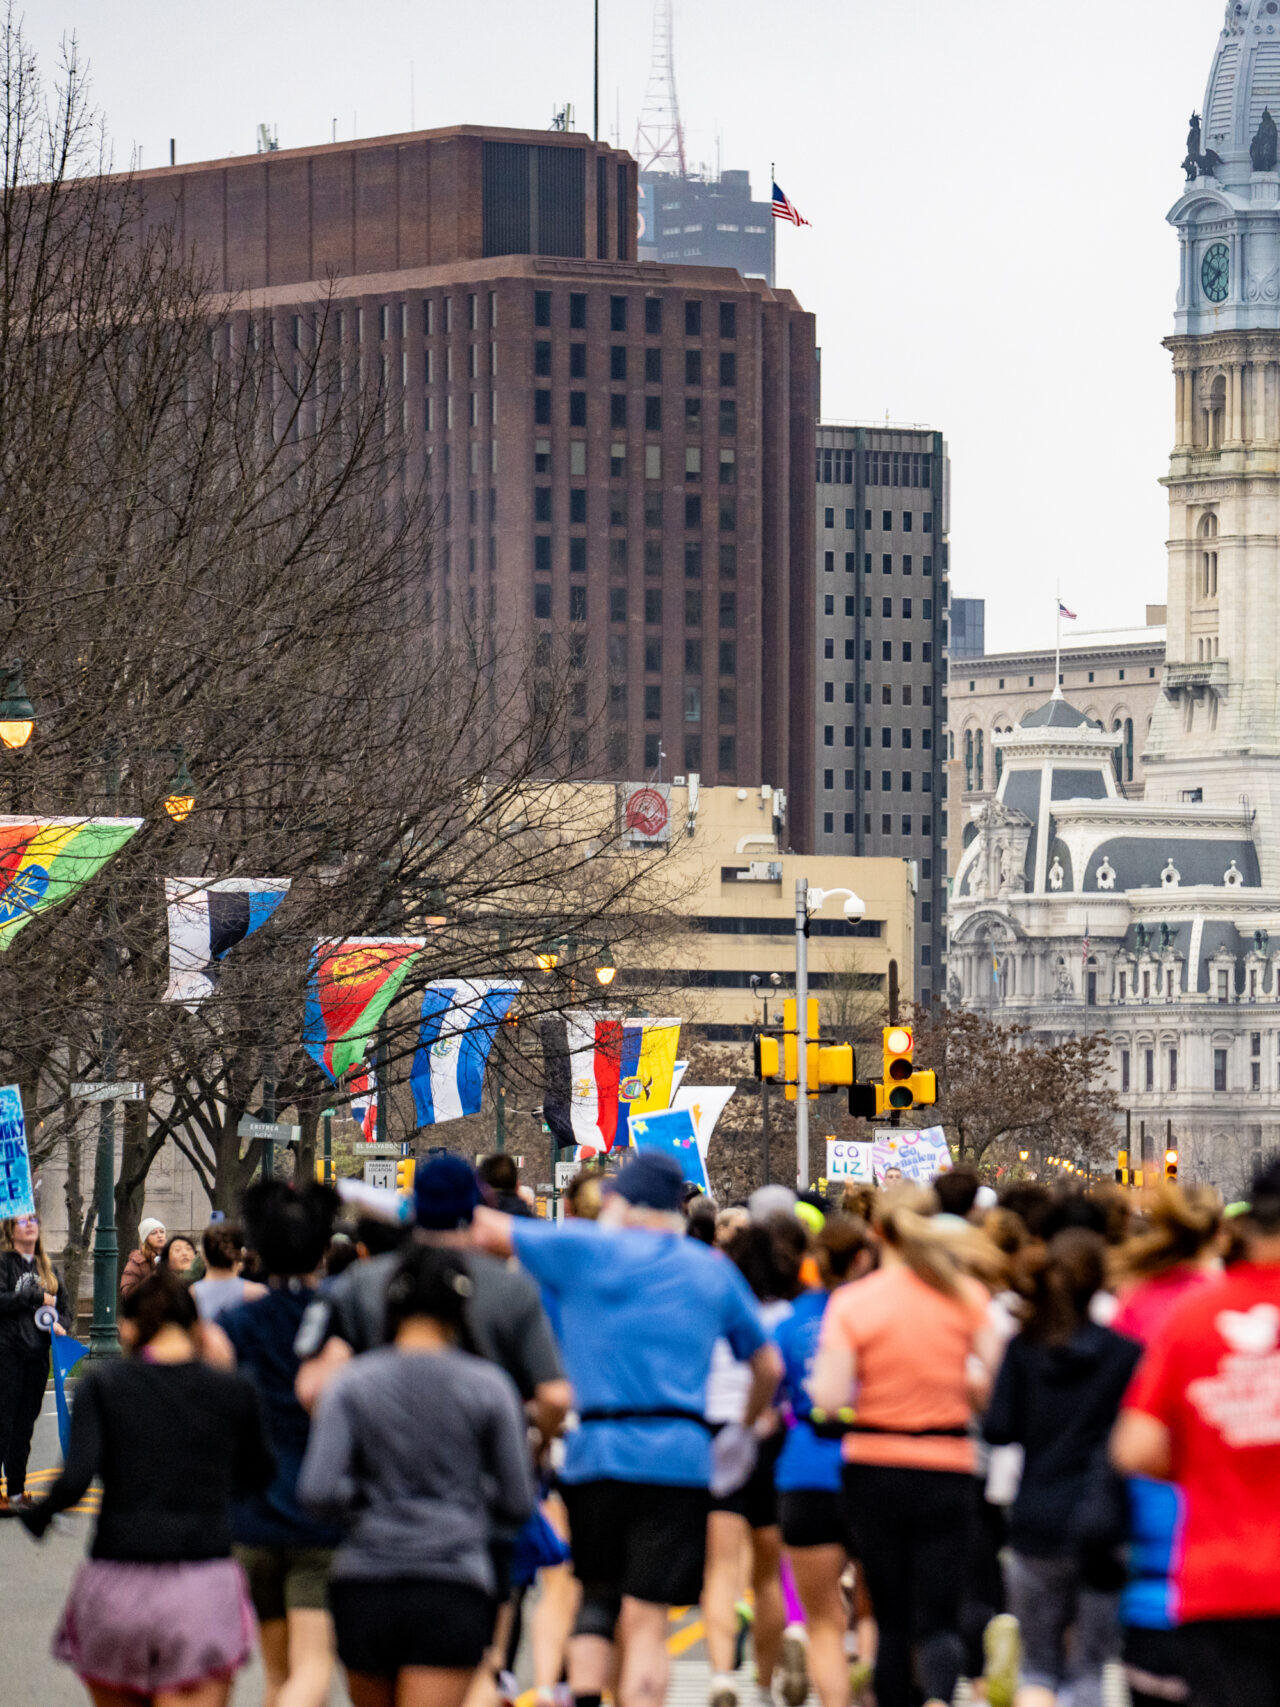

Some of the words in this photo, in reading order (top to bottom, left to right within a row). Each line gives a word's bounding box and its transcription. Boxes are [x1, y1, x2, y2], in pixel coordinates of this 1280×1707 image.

[249, 1123, 279, 1132] ERITREA
[833, 1144, 859, 1159] GO
[832, 1160, 865, 1176] LIZ
